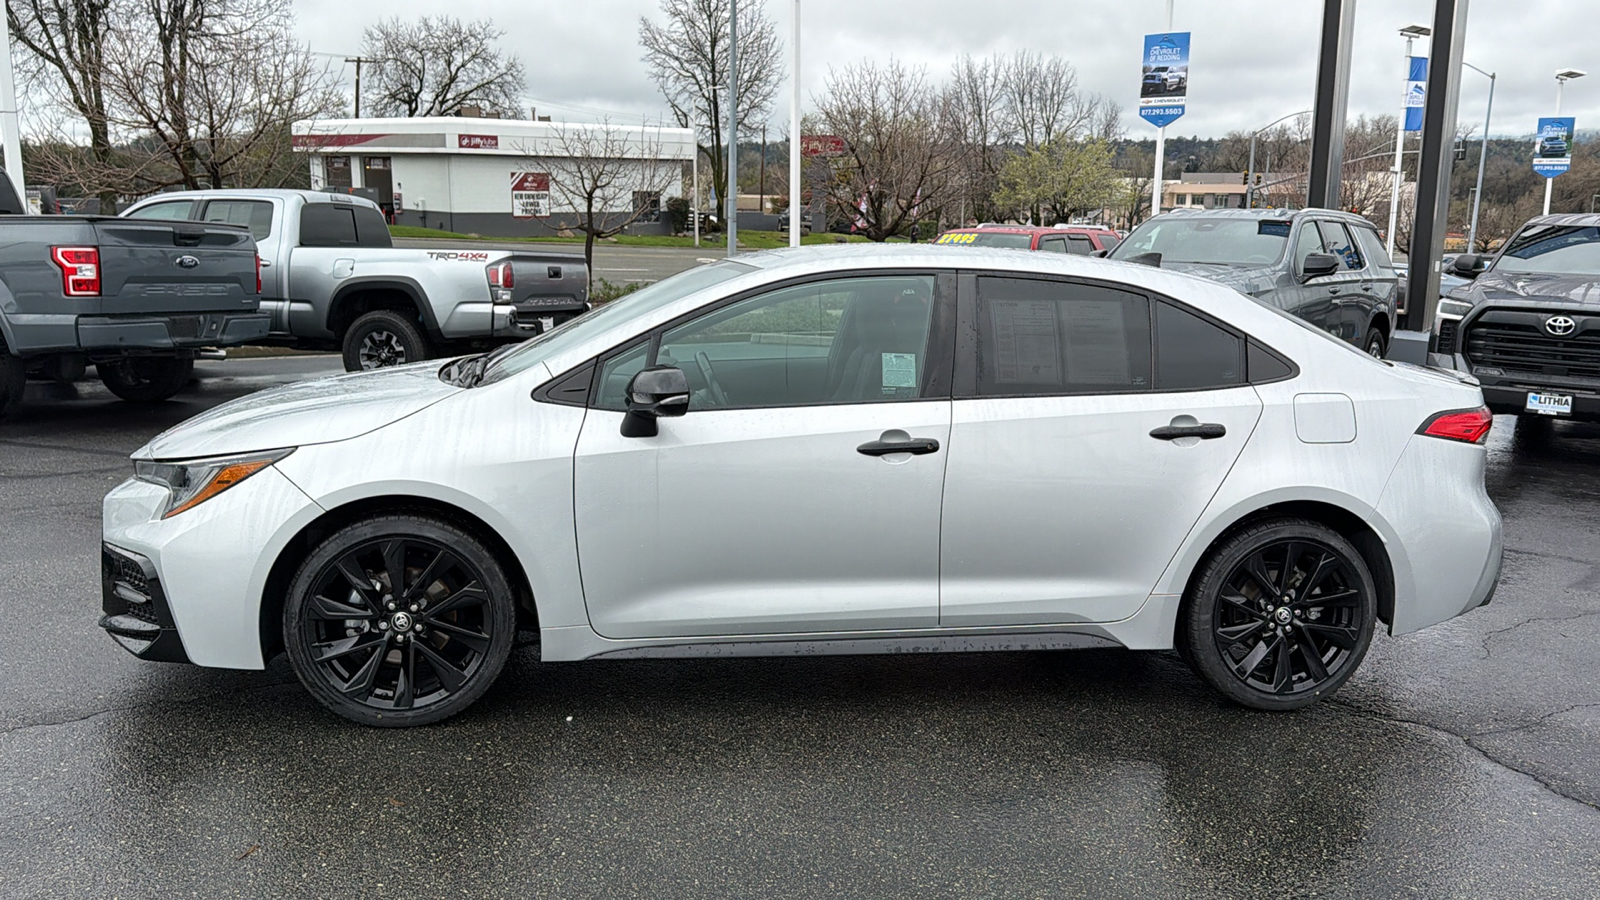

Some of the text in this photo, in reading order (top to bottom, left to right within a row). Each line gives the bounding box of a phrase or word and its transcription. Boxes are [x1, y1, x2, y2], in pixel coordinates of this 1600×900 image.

[1150, 47, 1181, 56] CHEVROLET
[1141, 107, 1182, 116] 877.293.5503
[937, 233, 979, 244] 27495
[1538, 395, 1570, 406] LITHIA
